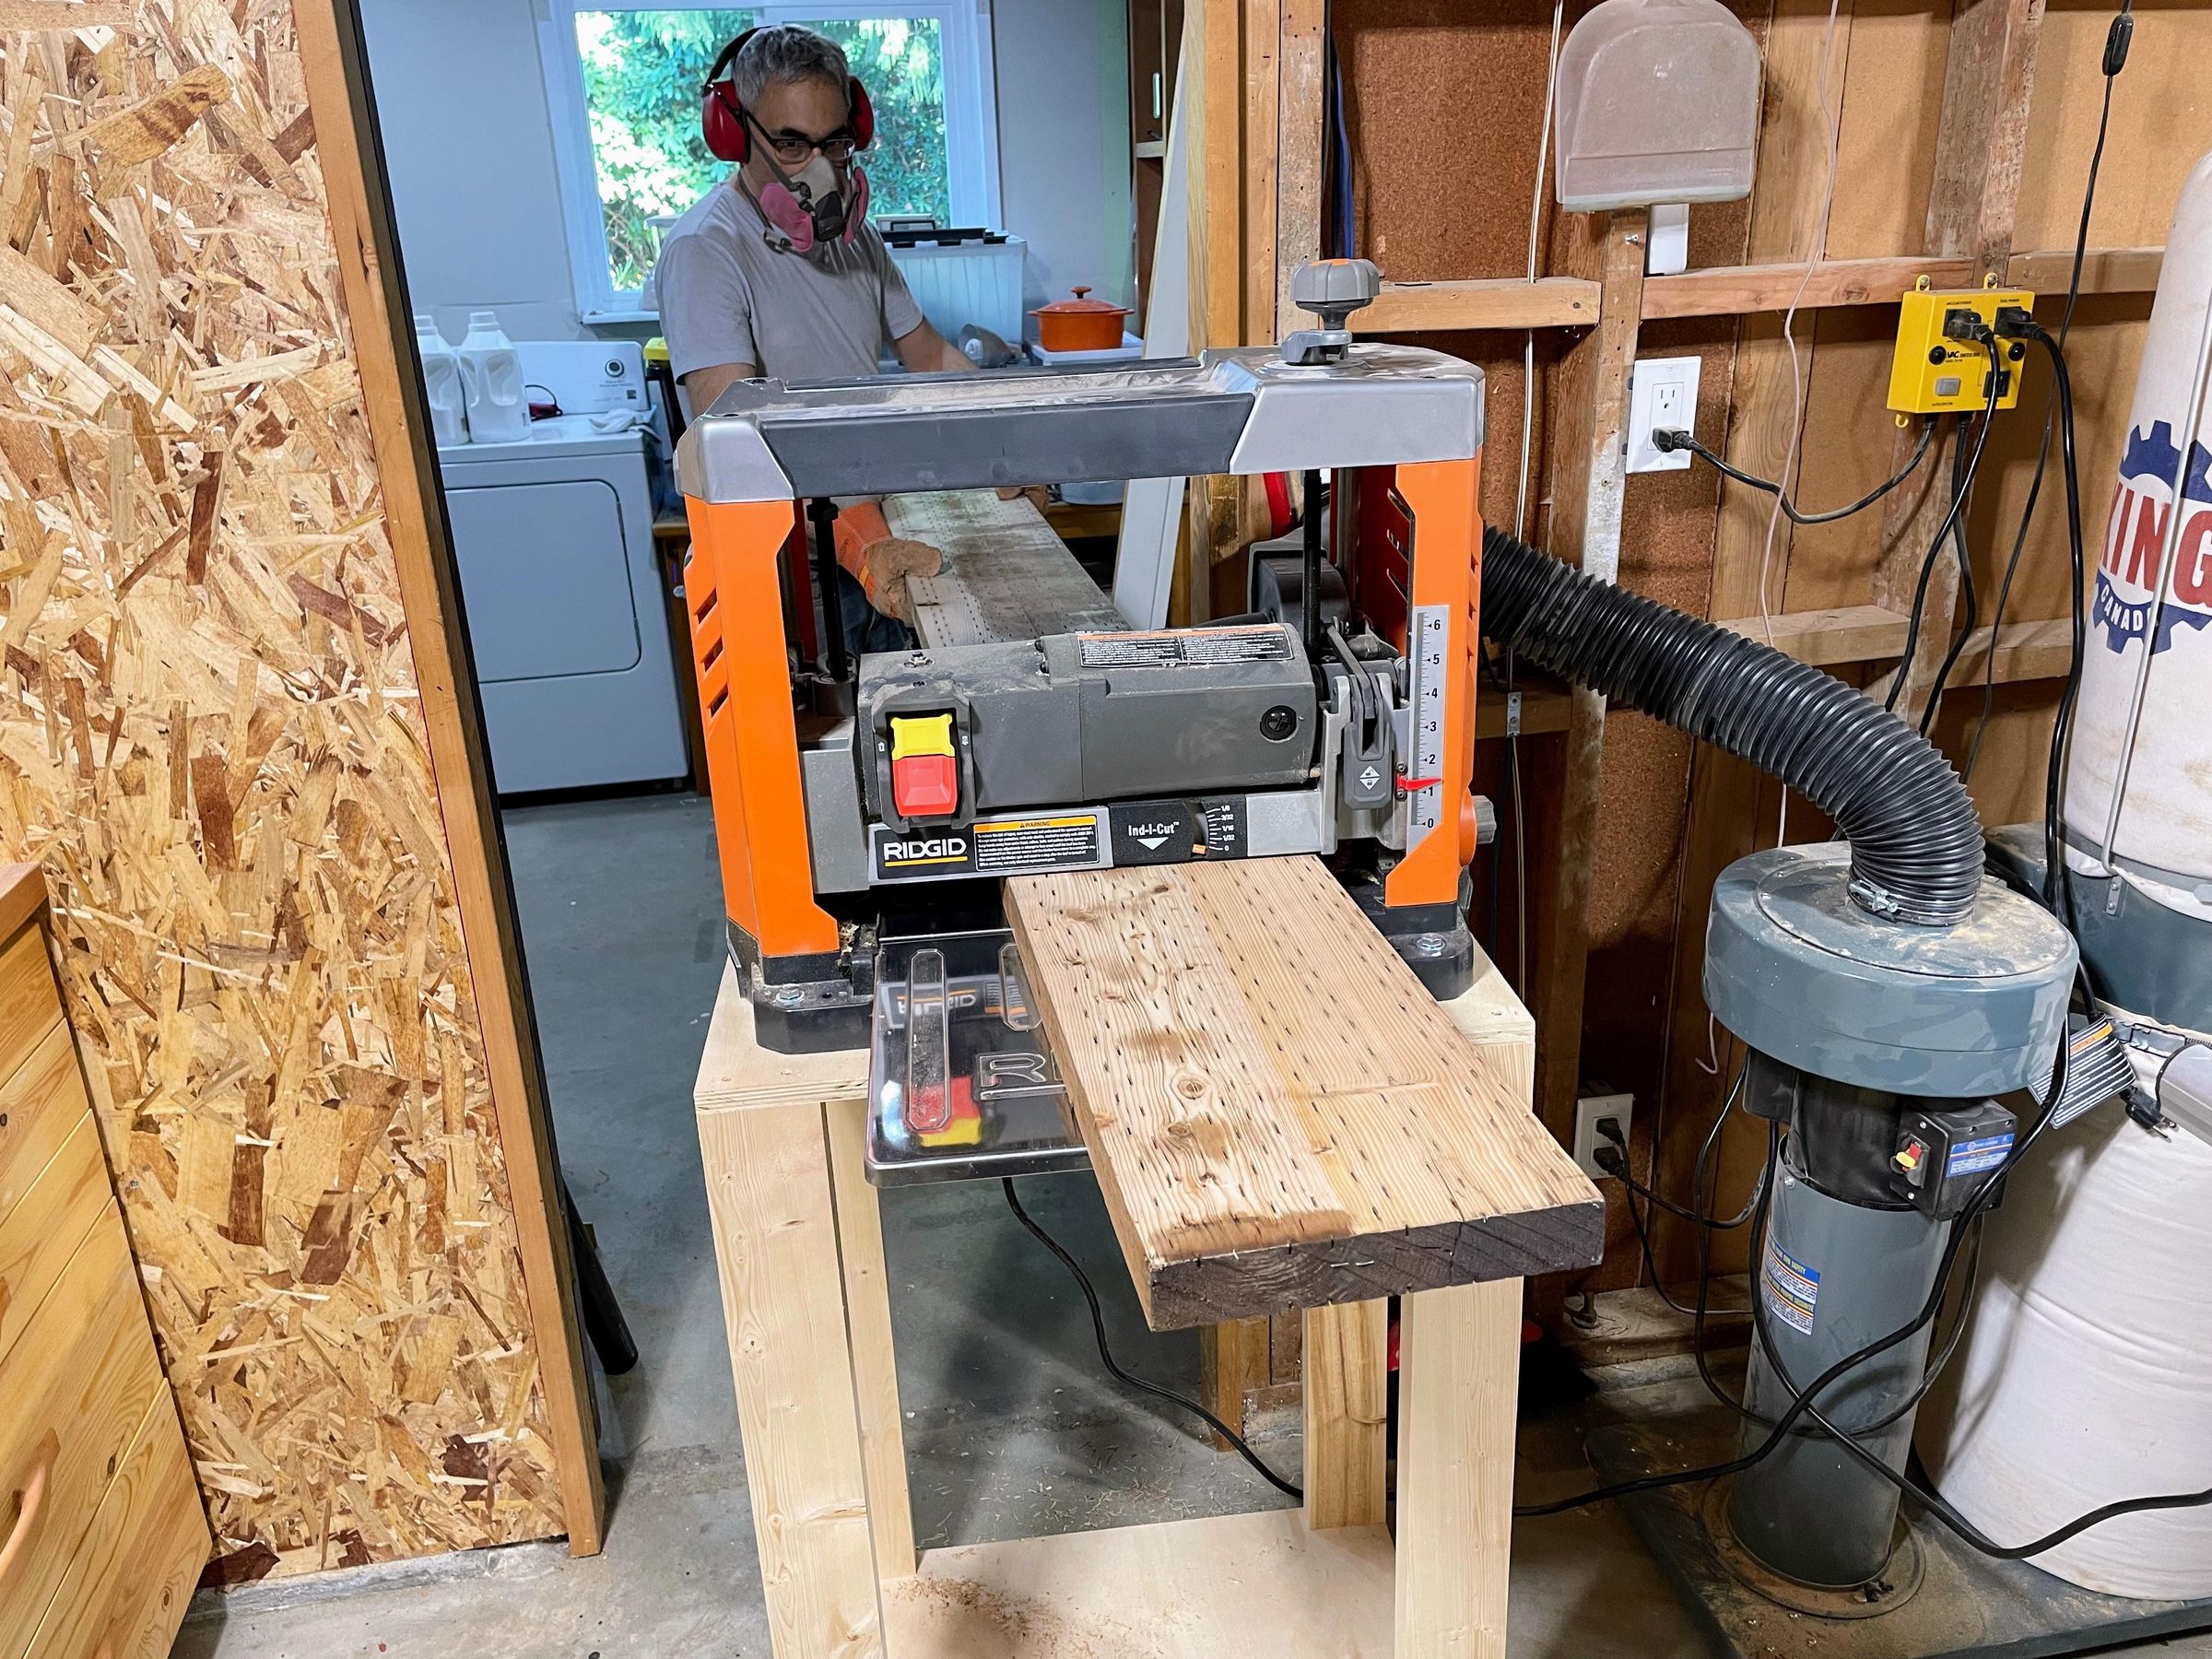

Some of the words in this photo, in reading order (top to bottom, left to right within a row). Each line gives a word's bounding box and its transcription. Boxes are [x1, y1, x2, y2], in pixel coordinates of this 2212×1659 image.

[1433, 618, 1441, 630] 6
[1432, 653, 1440, 665] 5
[1430, 688, 1438, 699] 4
[1430, 721, 1437, 732] 3
[1428, 754, 1436, 765] 2
[1429, 787, 1434, 796] 1
[1427, 818, 1434, 829] 0
[883, 838, 967, 860] RIDGID
